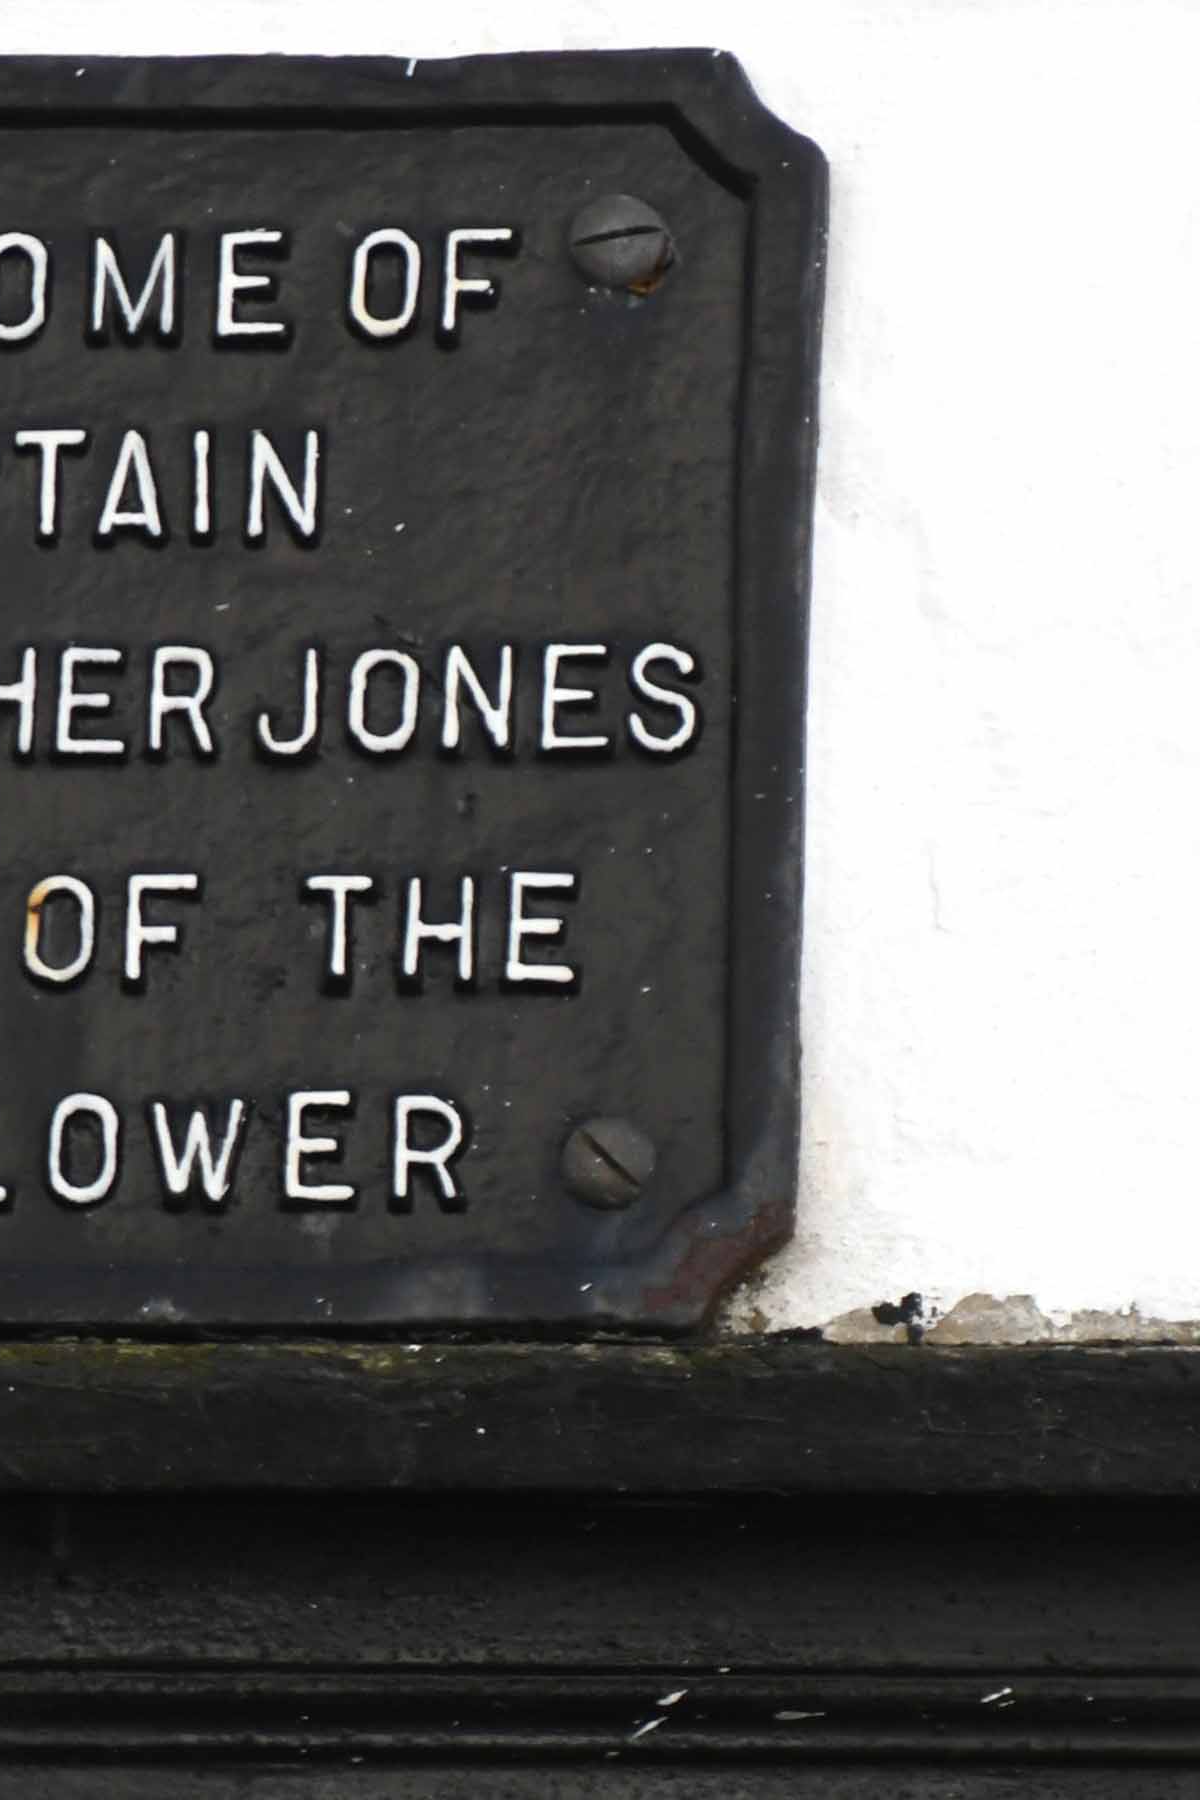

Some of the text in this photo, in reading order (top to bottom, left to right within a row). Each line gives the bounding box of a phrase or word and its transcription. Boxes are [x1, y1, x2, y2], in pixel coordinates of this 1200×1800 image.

[350, 227, 513, 337] OF
[258, 642, 696, 754] JONES
[23, 873, 198, 982] OF
[306, 871, 574, 982] THE
